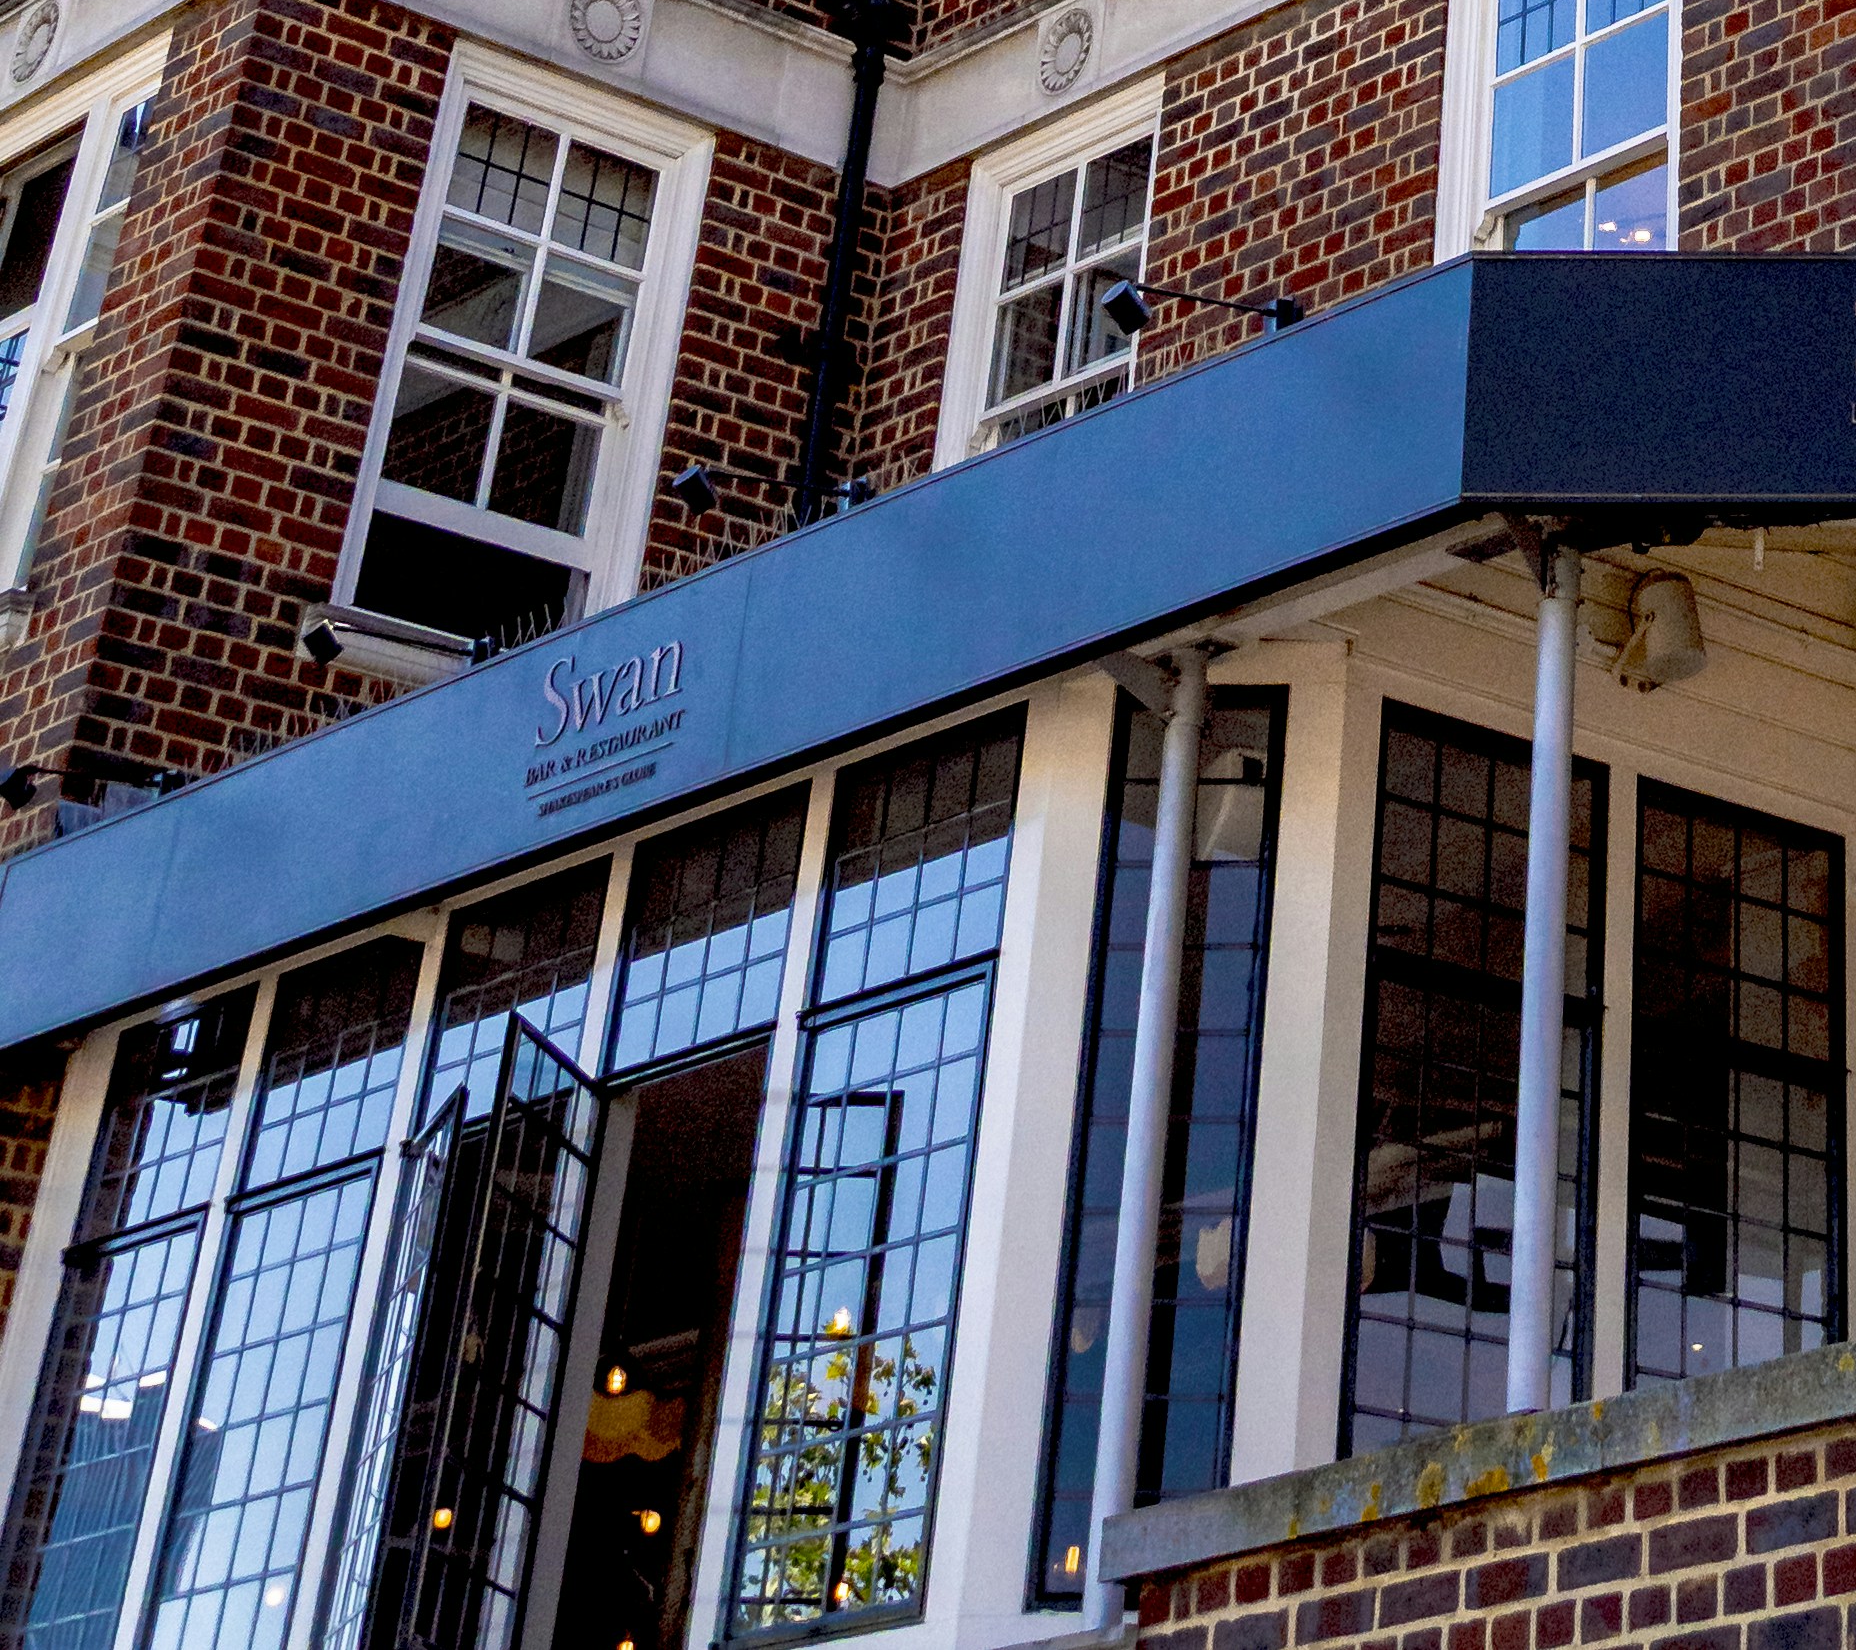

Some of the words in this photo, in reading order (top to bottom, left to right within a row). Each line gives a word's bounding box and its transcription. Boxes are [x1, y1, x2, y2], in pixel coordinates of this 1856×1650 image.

[533, 639, 684, 749] Swan
[524, 759, 558, 788] BAR
[560, 753, 574, 774] &
[575, 709, 687, 768] RESTAURANT
